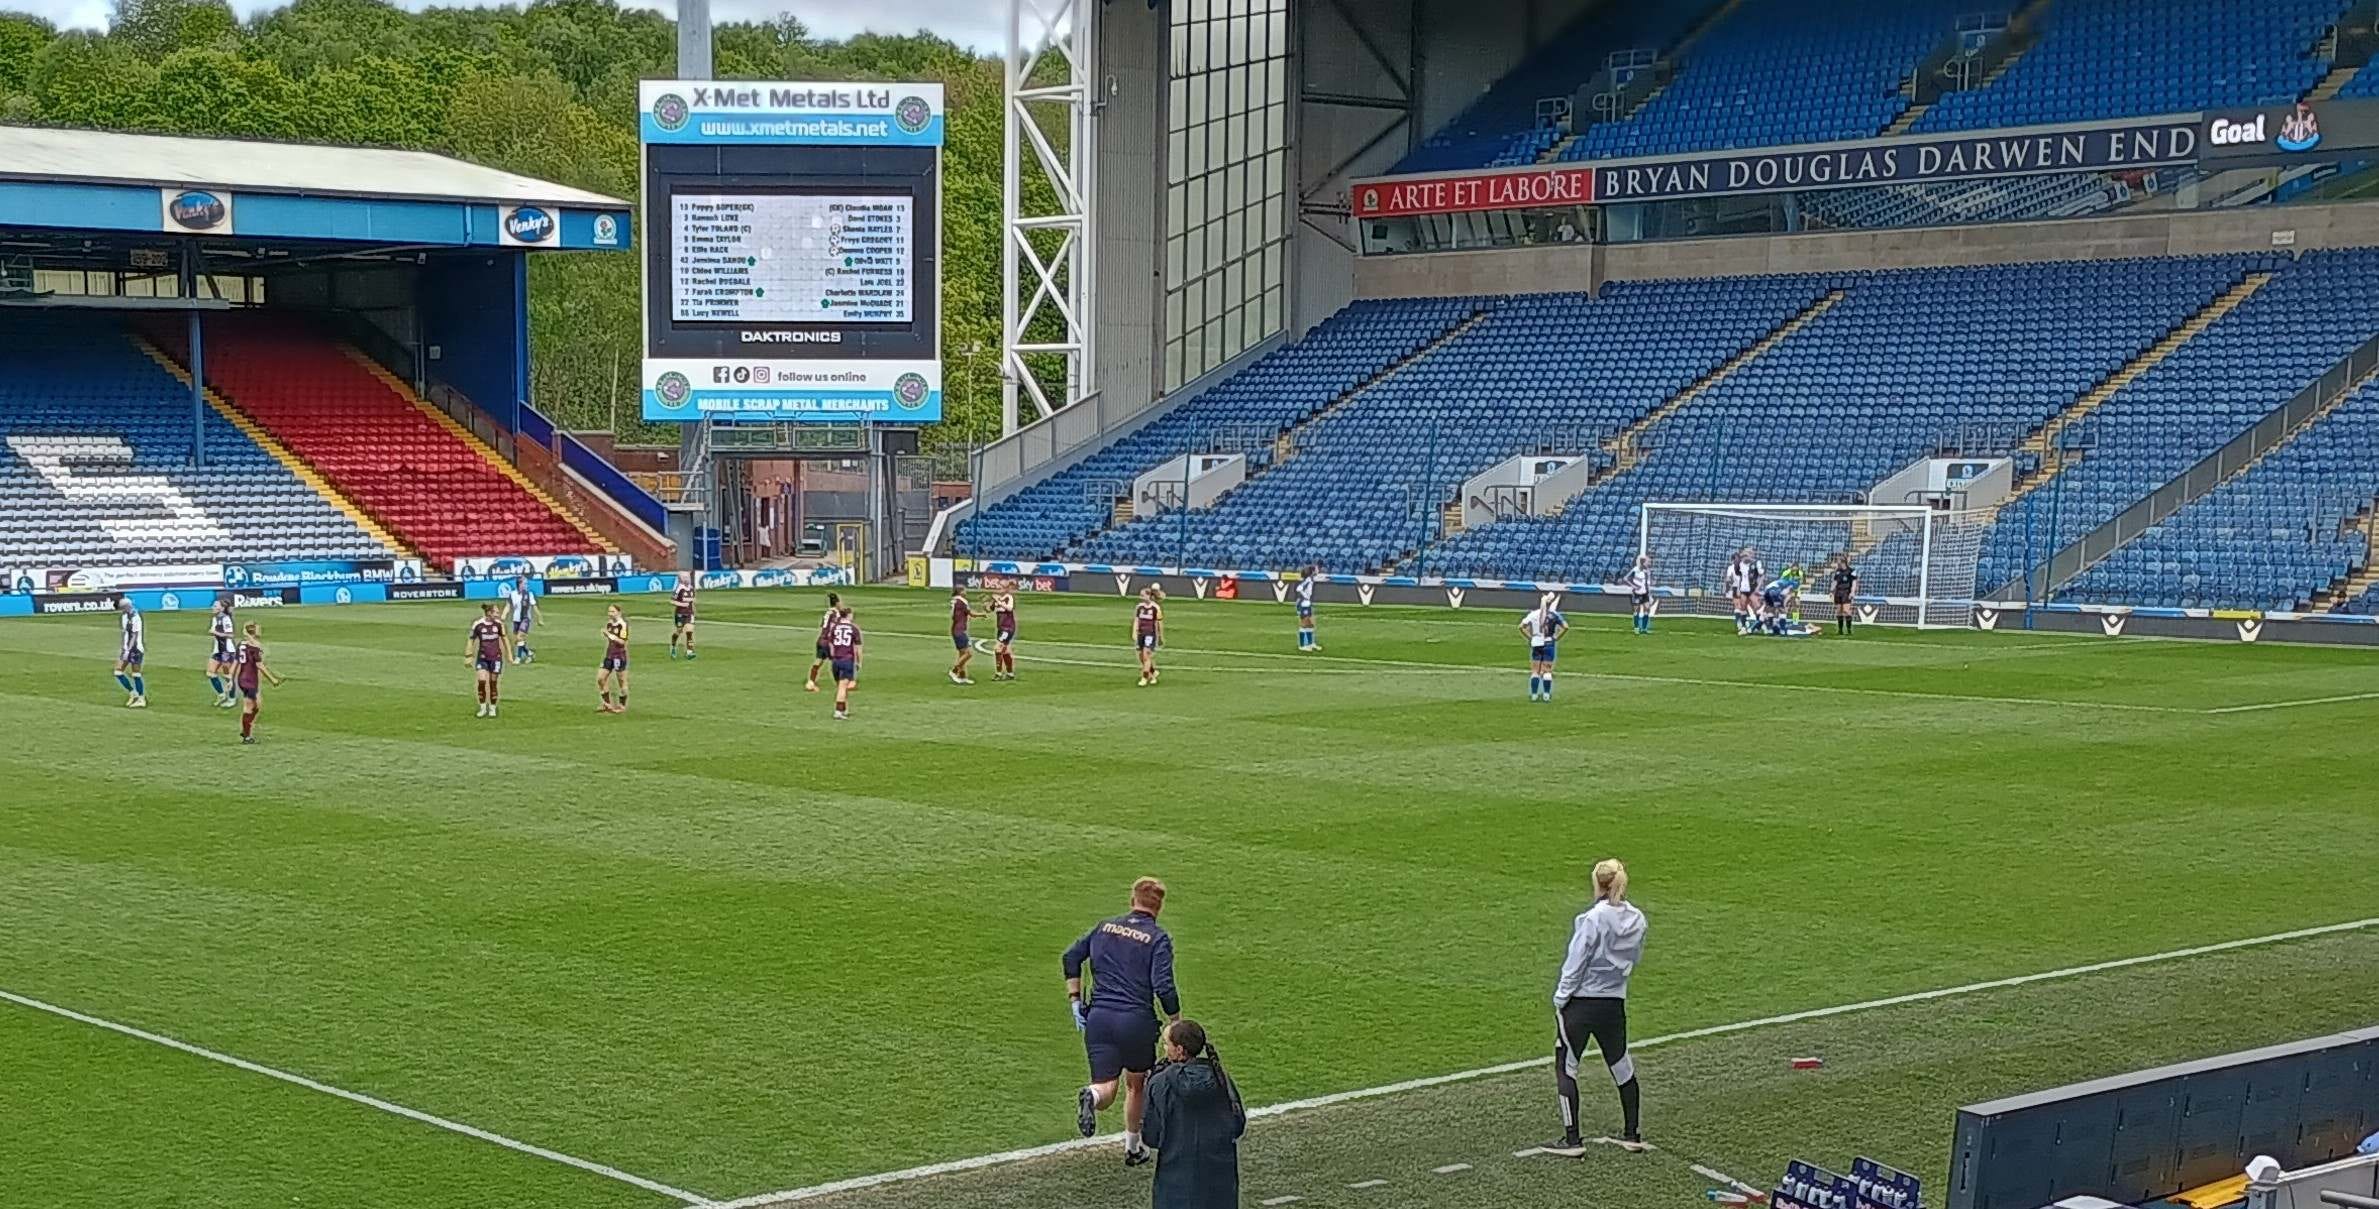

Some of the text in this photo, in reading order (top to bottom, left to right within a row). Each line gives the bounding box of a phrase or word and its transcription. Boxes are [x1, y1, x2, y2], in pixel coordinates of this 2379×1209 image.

[769, 89, 850, 109] Metals
[856, 90, 890, 109] Ltd
[701, 120, 888, 137] www.xmetmetals.net
[2210, 113, 2266, 145] Goal
[1606, 127, 2197, 198] BRYAN DOUGLAS DARWEN END
[1389, 173, 1582, 210] ARTE ET LABORE
[509, 215, 549, 235] Venky's
[741, 331, 842, 343] DAKTRONICS
[777, 371, 866, 382] follow us online
[697, 400, 889, 412] MOBILE SCRAP METAL MERCHANTS
[967, 574, 981, 590] sky
[1018, 576, 1034, 591] sky
[1035, 577, 1053, 592] bet
[234, 594, 283, 607] Rovers
[393, 590, 458, 599] ROVERSTORE
[43, 597, 115, 613] rovers.co.uk
[833, 629, 853, 647] 35
[1102, 923, 1152, 944] macron
